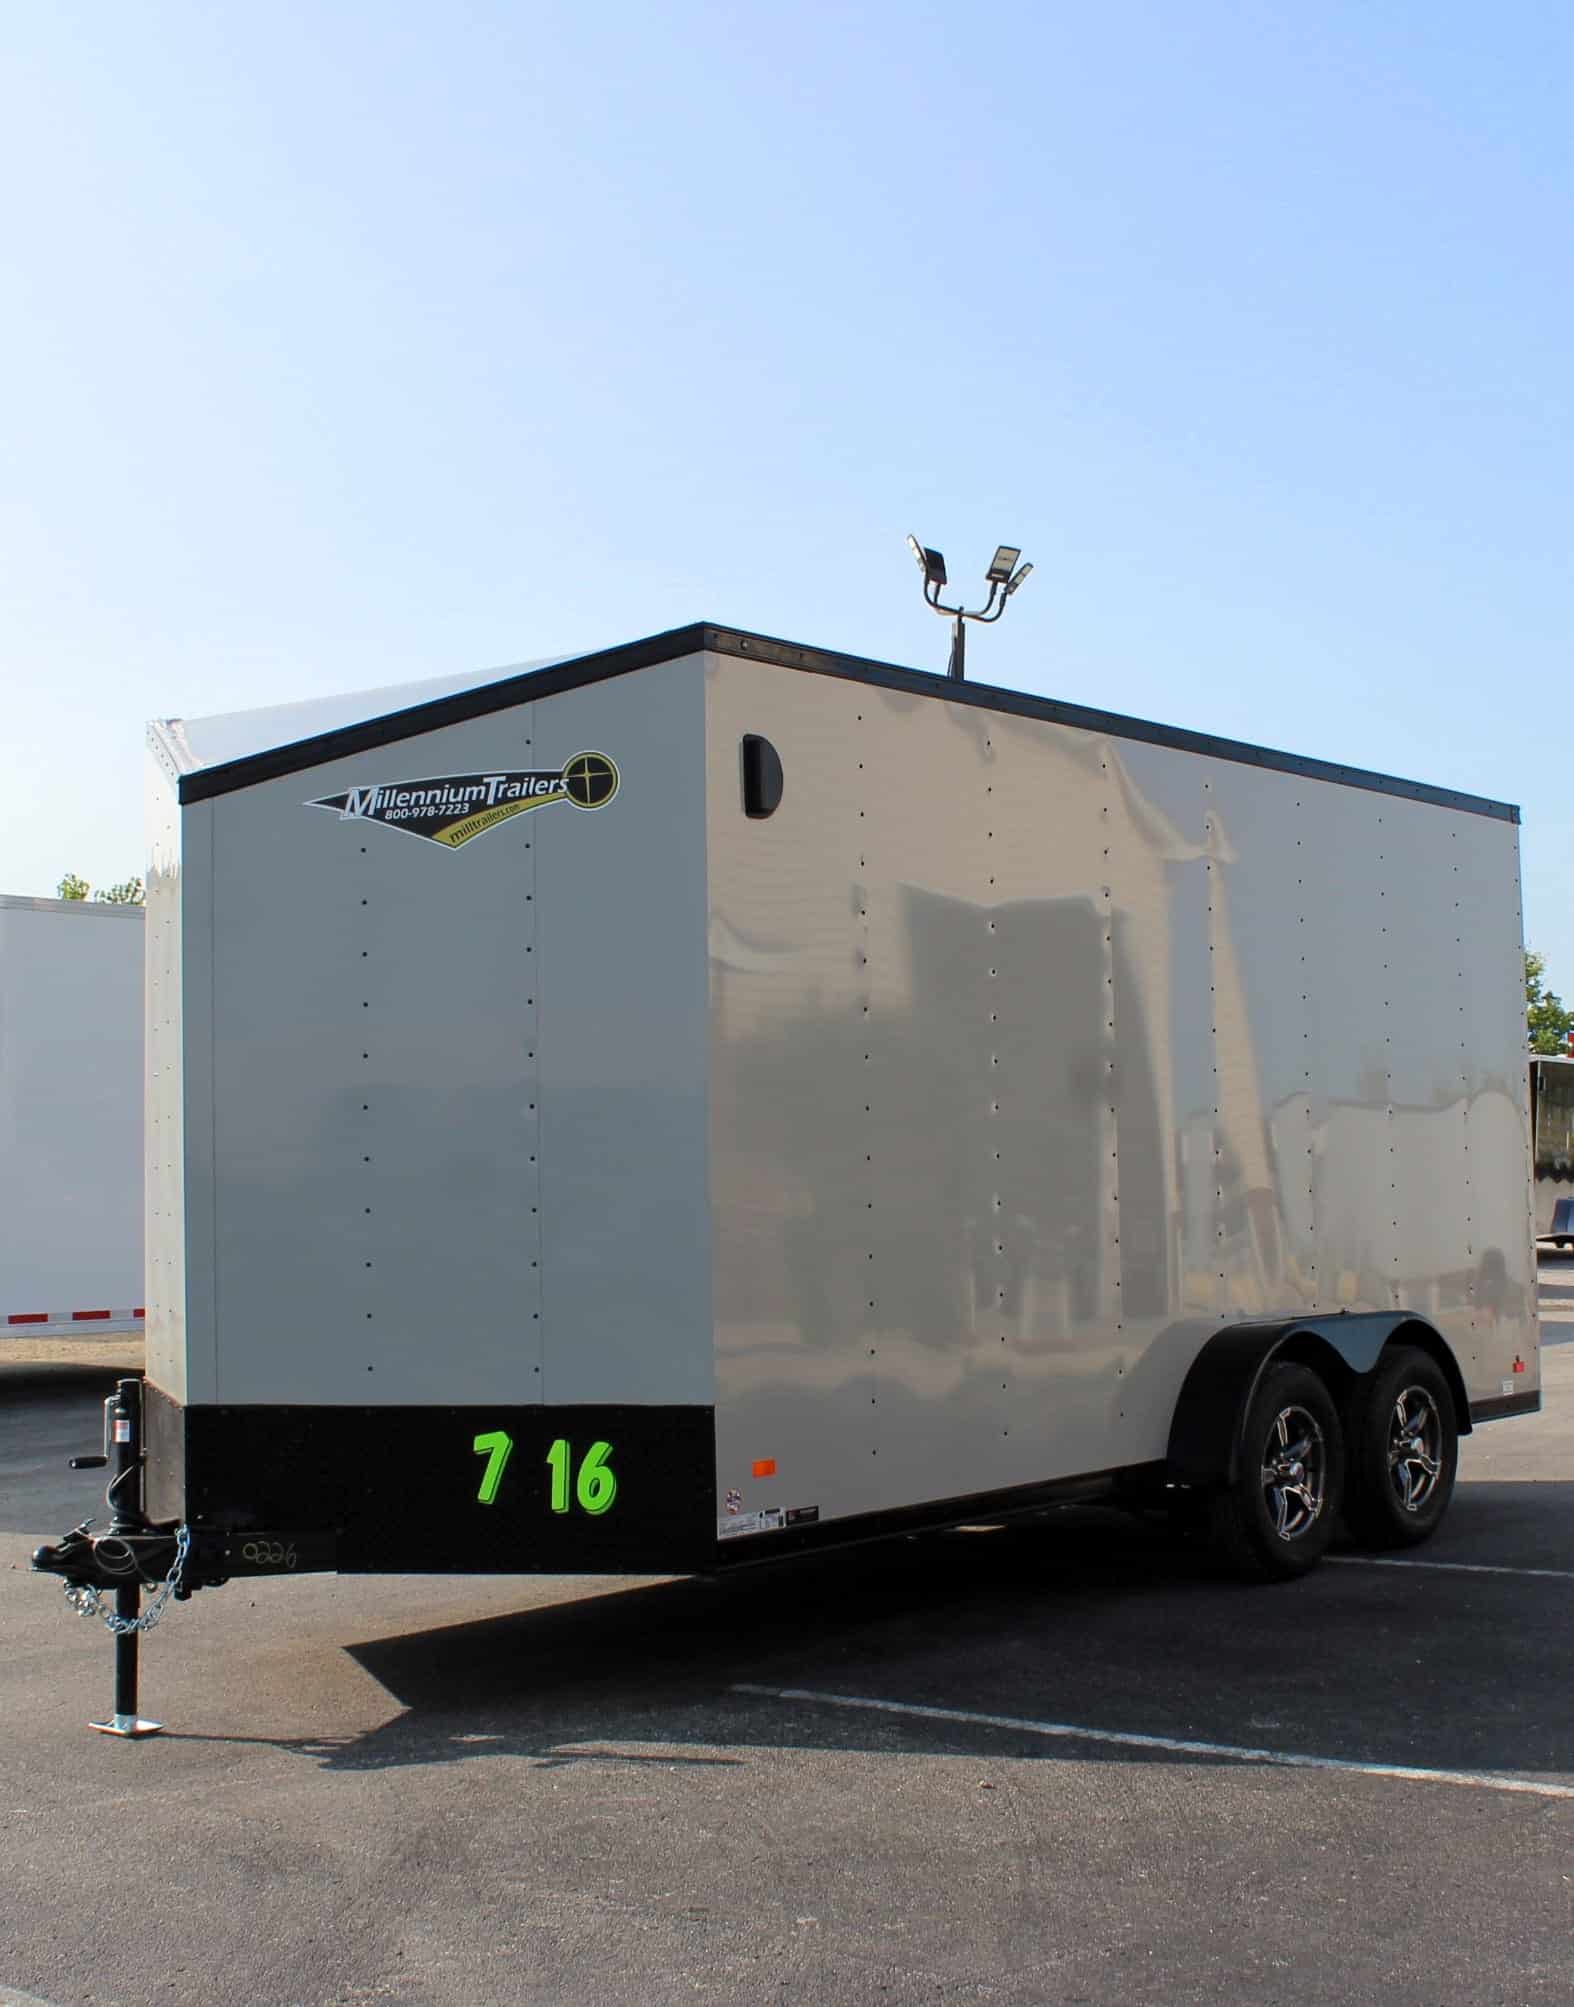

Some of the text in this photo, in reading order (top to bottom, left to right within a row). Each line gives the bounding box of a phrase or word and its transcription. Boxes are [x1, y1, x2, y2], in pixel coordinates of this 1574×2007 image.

[384, 803, 470, 820] 800-978-7223
[449, 803, 521, 843] milltrailers.com
[472, 1430, 618, 1516] 7 16
